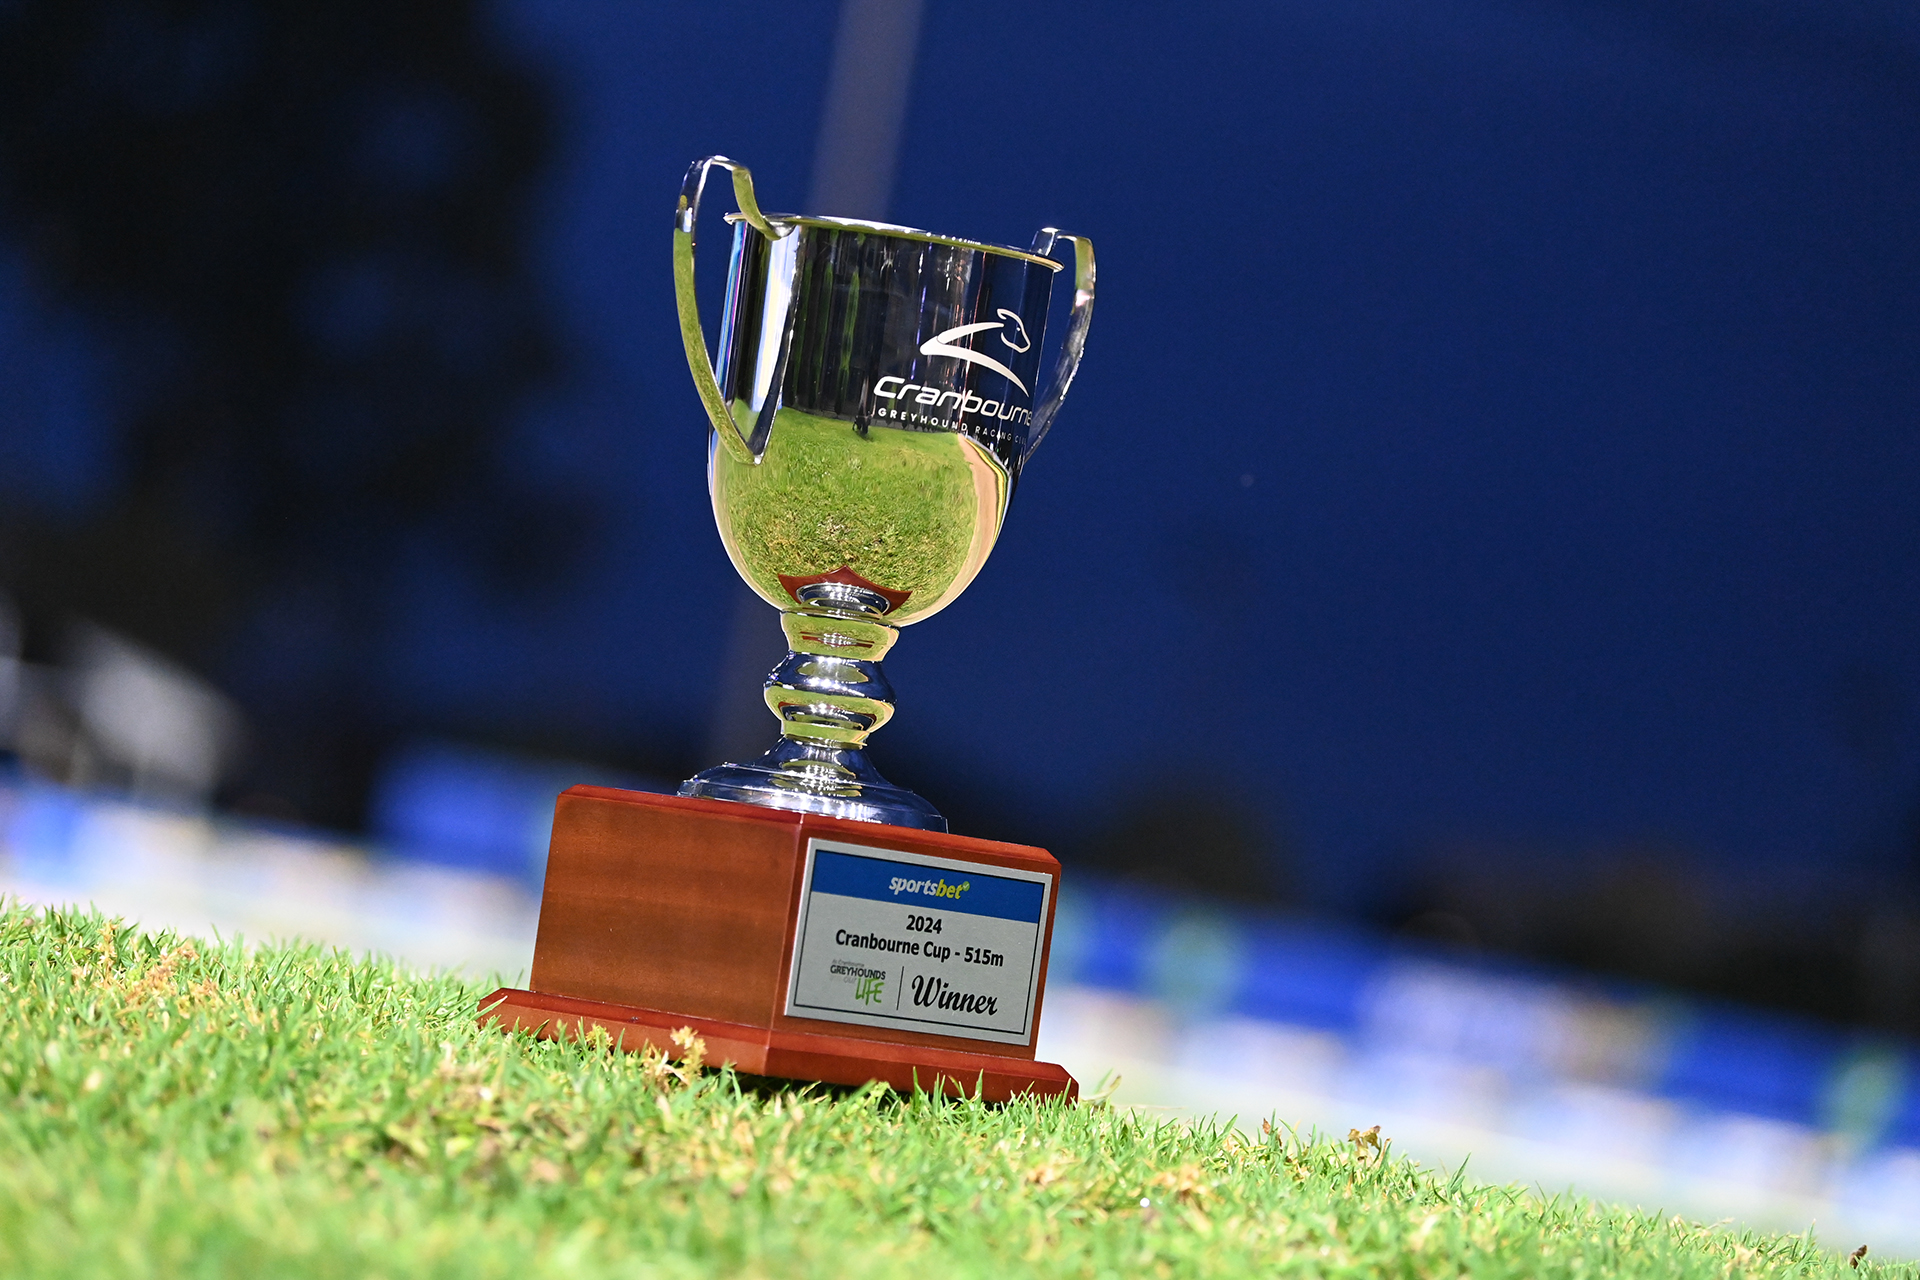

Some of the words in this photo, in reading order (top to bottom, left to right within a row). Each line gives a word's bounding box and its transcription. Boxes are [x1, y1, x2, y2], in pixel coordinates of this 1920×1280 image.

[873, 375, 1032, 427] Cranbourne
[877, 407, 968, 431] GREYHOUND
[888, 875, 963, 900] sportsbet
[906, 914, 942, 934] 2024
[835, 929, 920, 955] Cranbourne
[923, 941, 951, 963] Cup
[964, 946, 1004, 967] 515m
[830, 964, 886, 980] GREYHOUNDS
[855, 978, 885, 1006] LIFE
[911, 974, 998, 1016] Winner
